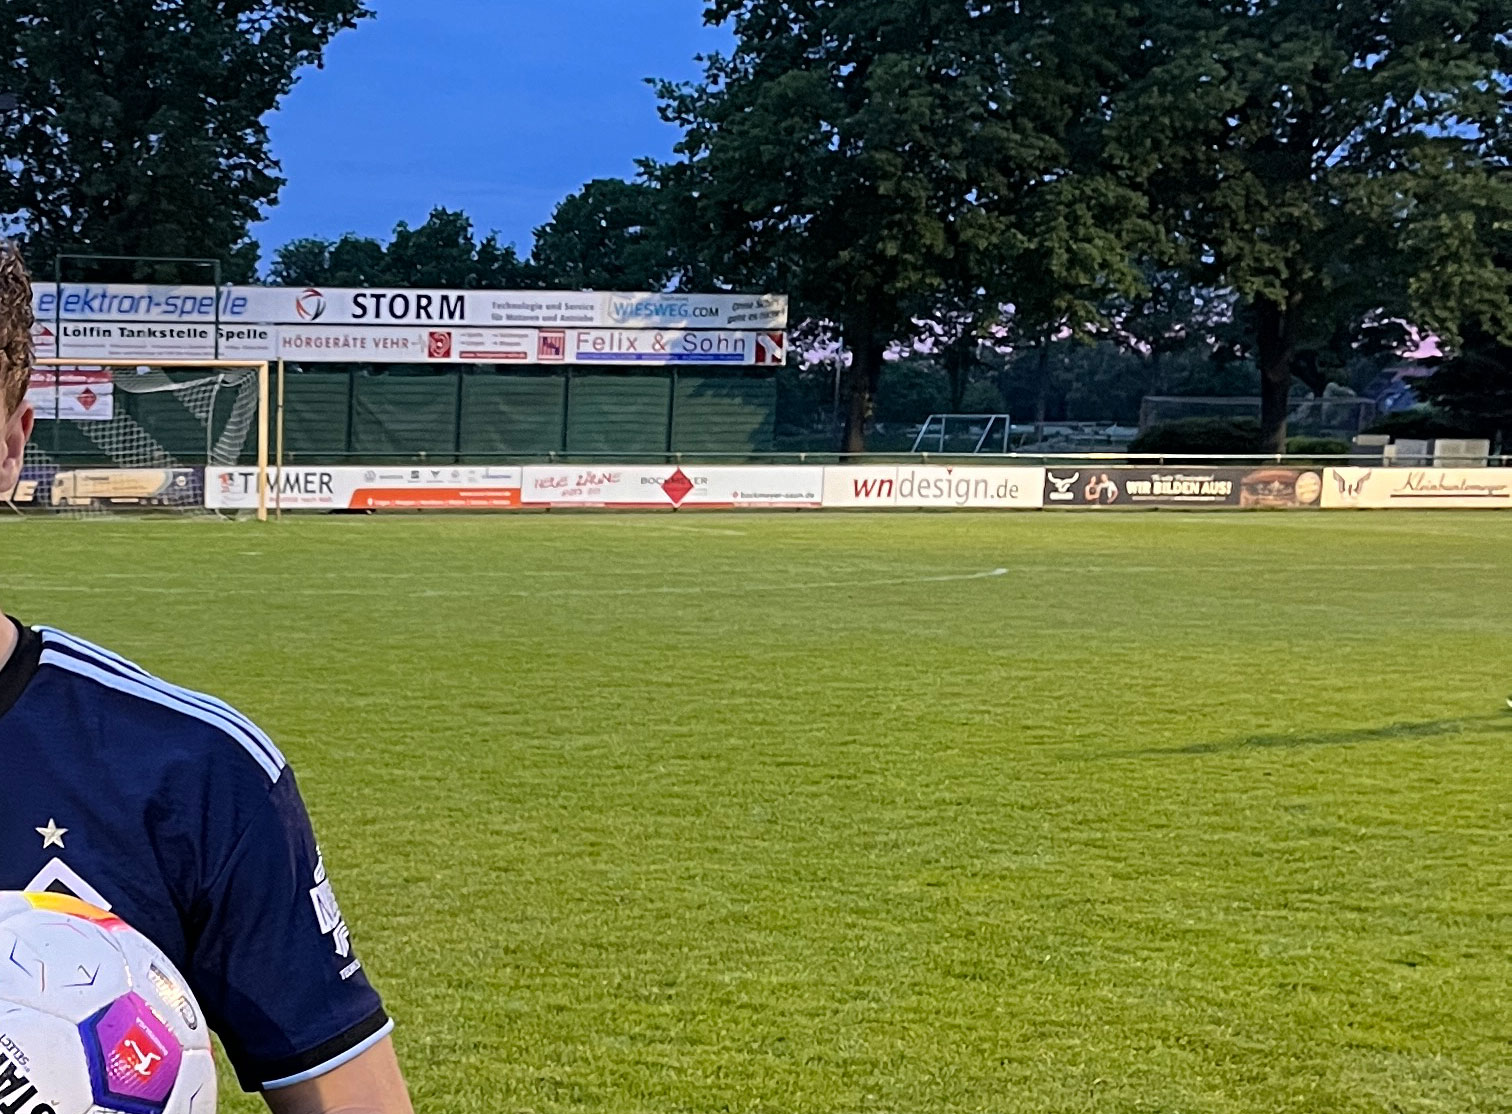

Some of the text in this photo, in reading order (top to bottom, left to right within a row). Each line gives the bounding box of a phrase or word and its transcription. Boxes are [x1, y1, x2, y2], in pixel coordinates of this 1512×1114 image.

[352, 293, 466, 320] STORM
[492, 301, 543, 311] Technologie
[546, 302, 562, 310] und
[118, 326, 208, 339] Tankstelle
[217, 328, 269, 342] Spelle
[283, 334, 367, 348] HÖRGERÄTE
[373, 337, 409, 349] VEHR
[576, 332, 746, 352] Felix & Sohn
[238, 472, 334, 494] TIMMER
[1126, 481, 1233, 495] WIR BILDEN AUS!
